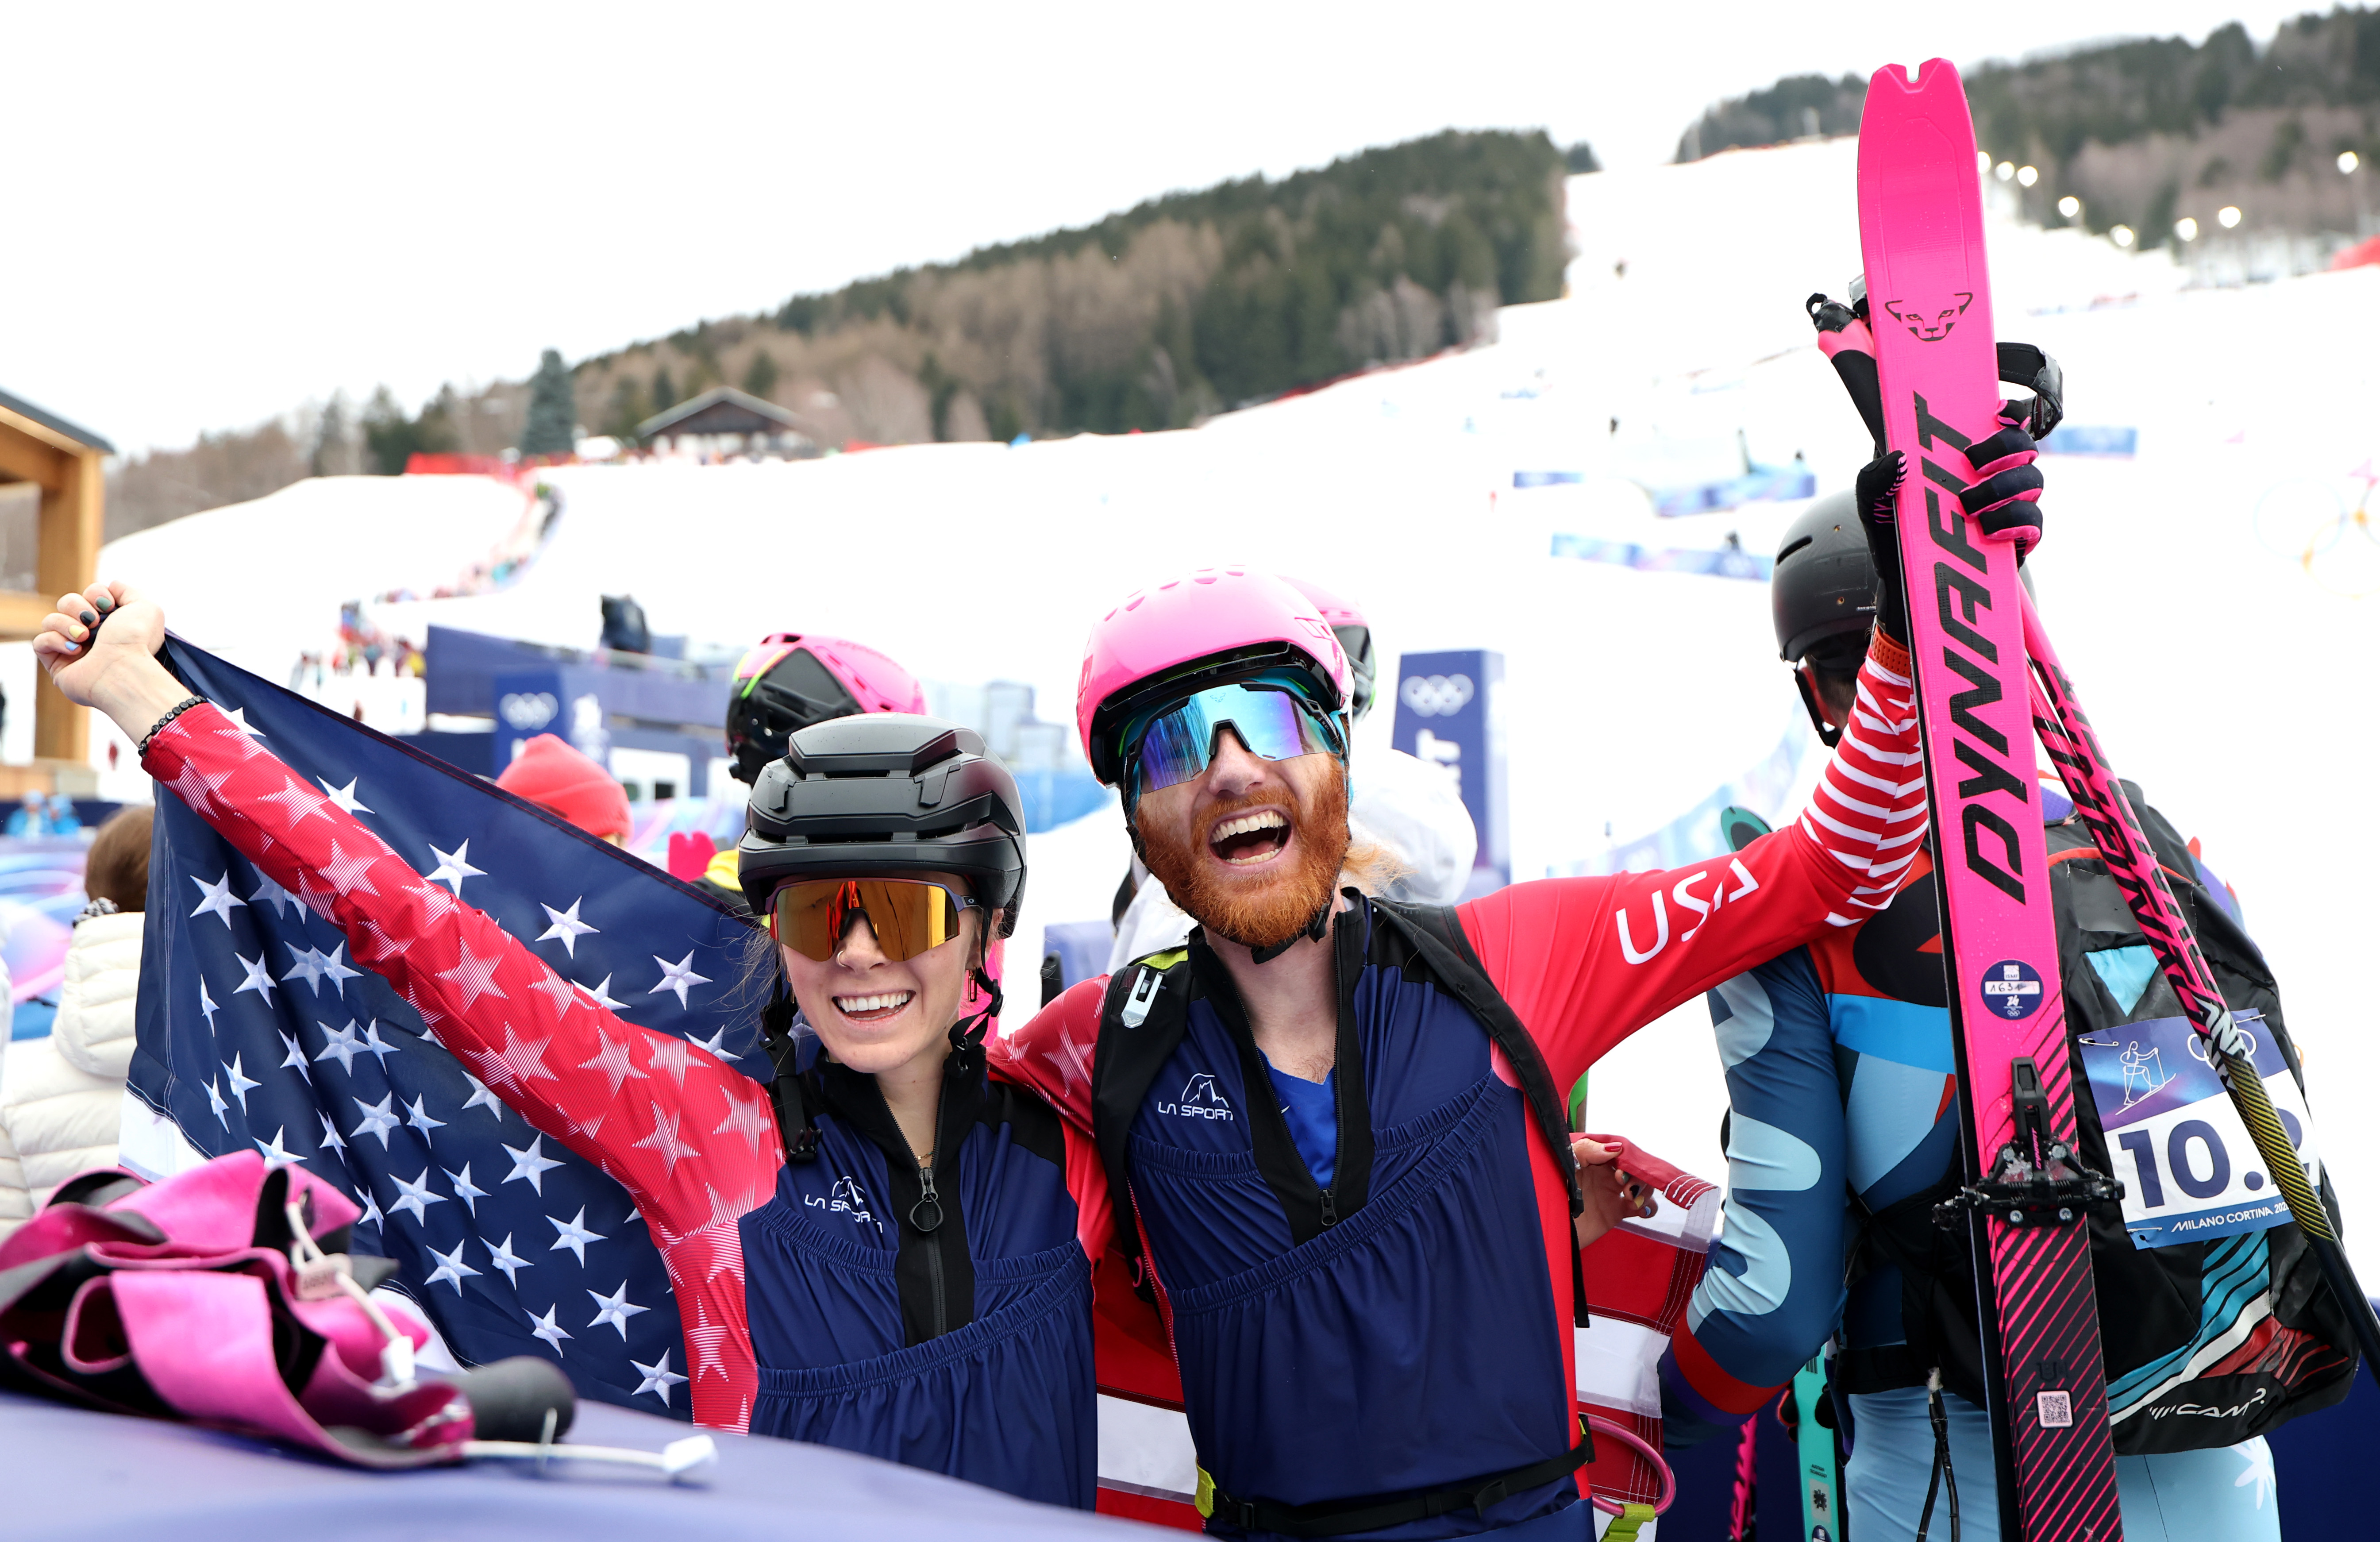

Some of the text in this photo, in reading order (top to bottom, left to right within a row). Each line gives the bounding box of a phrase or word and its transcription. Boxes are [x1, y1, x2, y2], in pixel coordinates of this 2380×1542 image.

[1913, 390, 2028, 906] DYNAFIT
[1616, 858, 1760, 965] USA
[1158, 1101, 1177, 1115] LA
[805, 1194, 825, 1209] LA
[2171, 1215, 2225, 1232] MILANO
[2226, 1207, 2274, 1223] CORTINA
